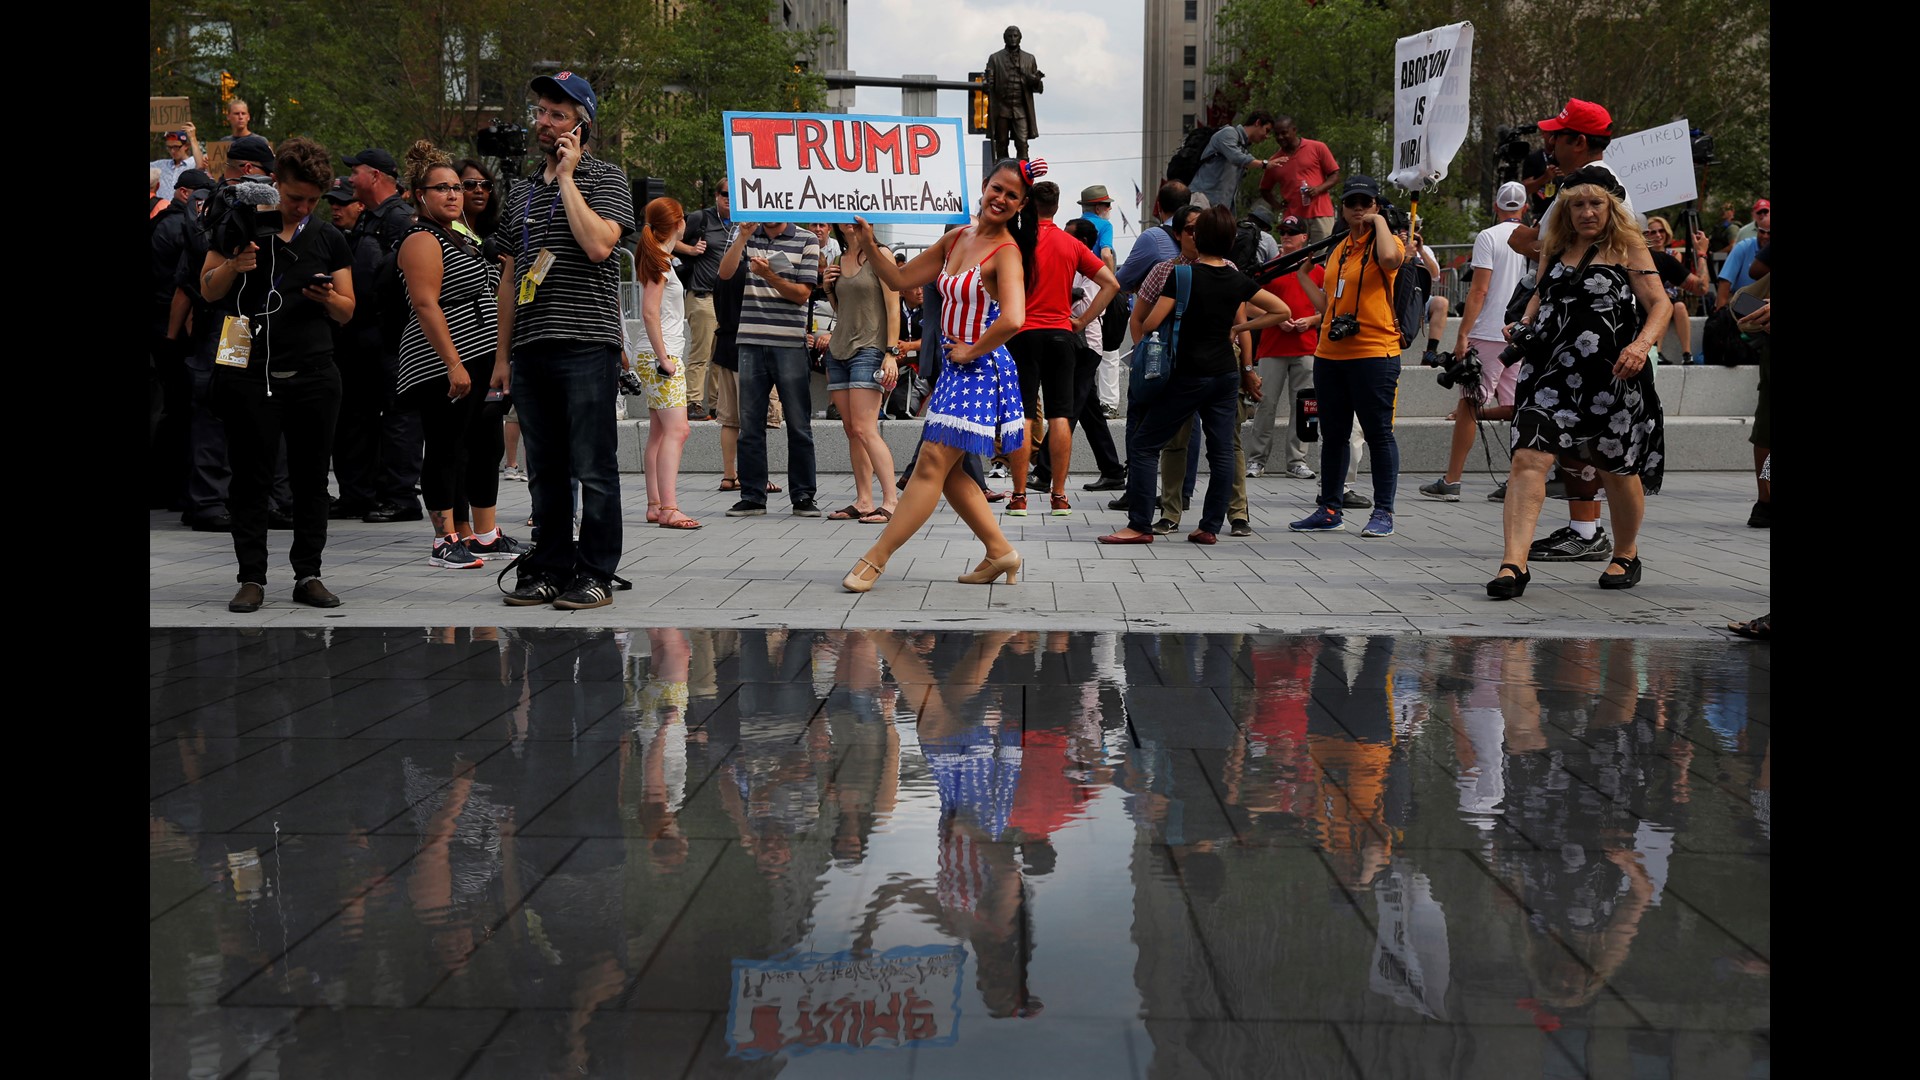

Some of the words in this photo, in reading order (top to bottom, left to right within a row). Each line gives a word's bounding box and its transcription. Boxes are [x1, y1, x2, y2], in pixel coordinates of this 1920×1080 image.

[1413, 95, 1427, 126] IS
[731, 117, 941, 175] TRUMP
[1635, 127, 1684, 147] TIRED
[1619, 155, 1677, 178] CARRYING
[740, 177, 794, 210] MAKE
[881, 178, 918, 212] HATE
[1635, 177, 1669, 195] SIGN
